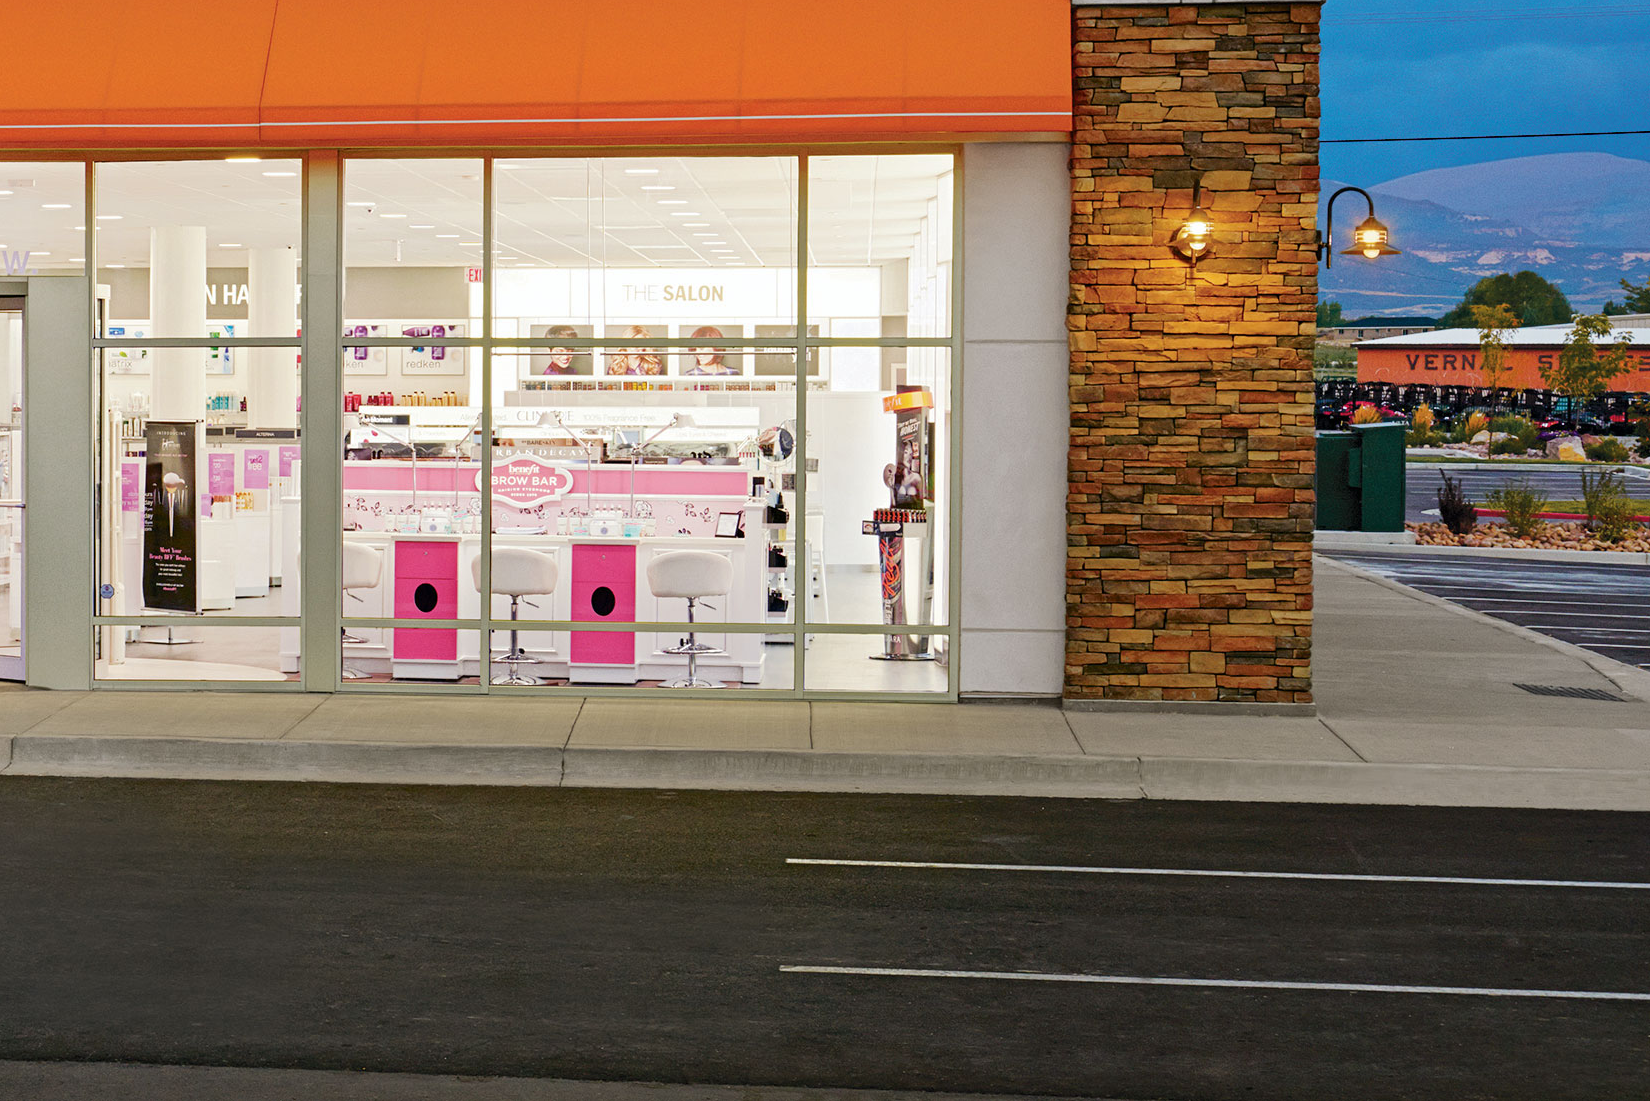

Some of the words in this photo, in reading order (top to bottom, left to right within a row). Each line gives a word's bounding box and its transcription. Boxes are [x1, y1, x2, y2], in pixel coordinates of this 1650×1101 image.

[1, 250, 38, 276] W.
[468, 268, 482, 283] EXI
[621, 284, 659, 302] THE
[662, 284, 725, 302] SALON
[406, 359, 442, 369] redken
[1406, 354, 1514, 372] VERNL
[508, 463, 540, 475] benefit
[492, 476, 528, 486] BROW
[532, 476, 558, 486] BAR
